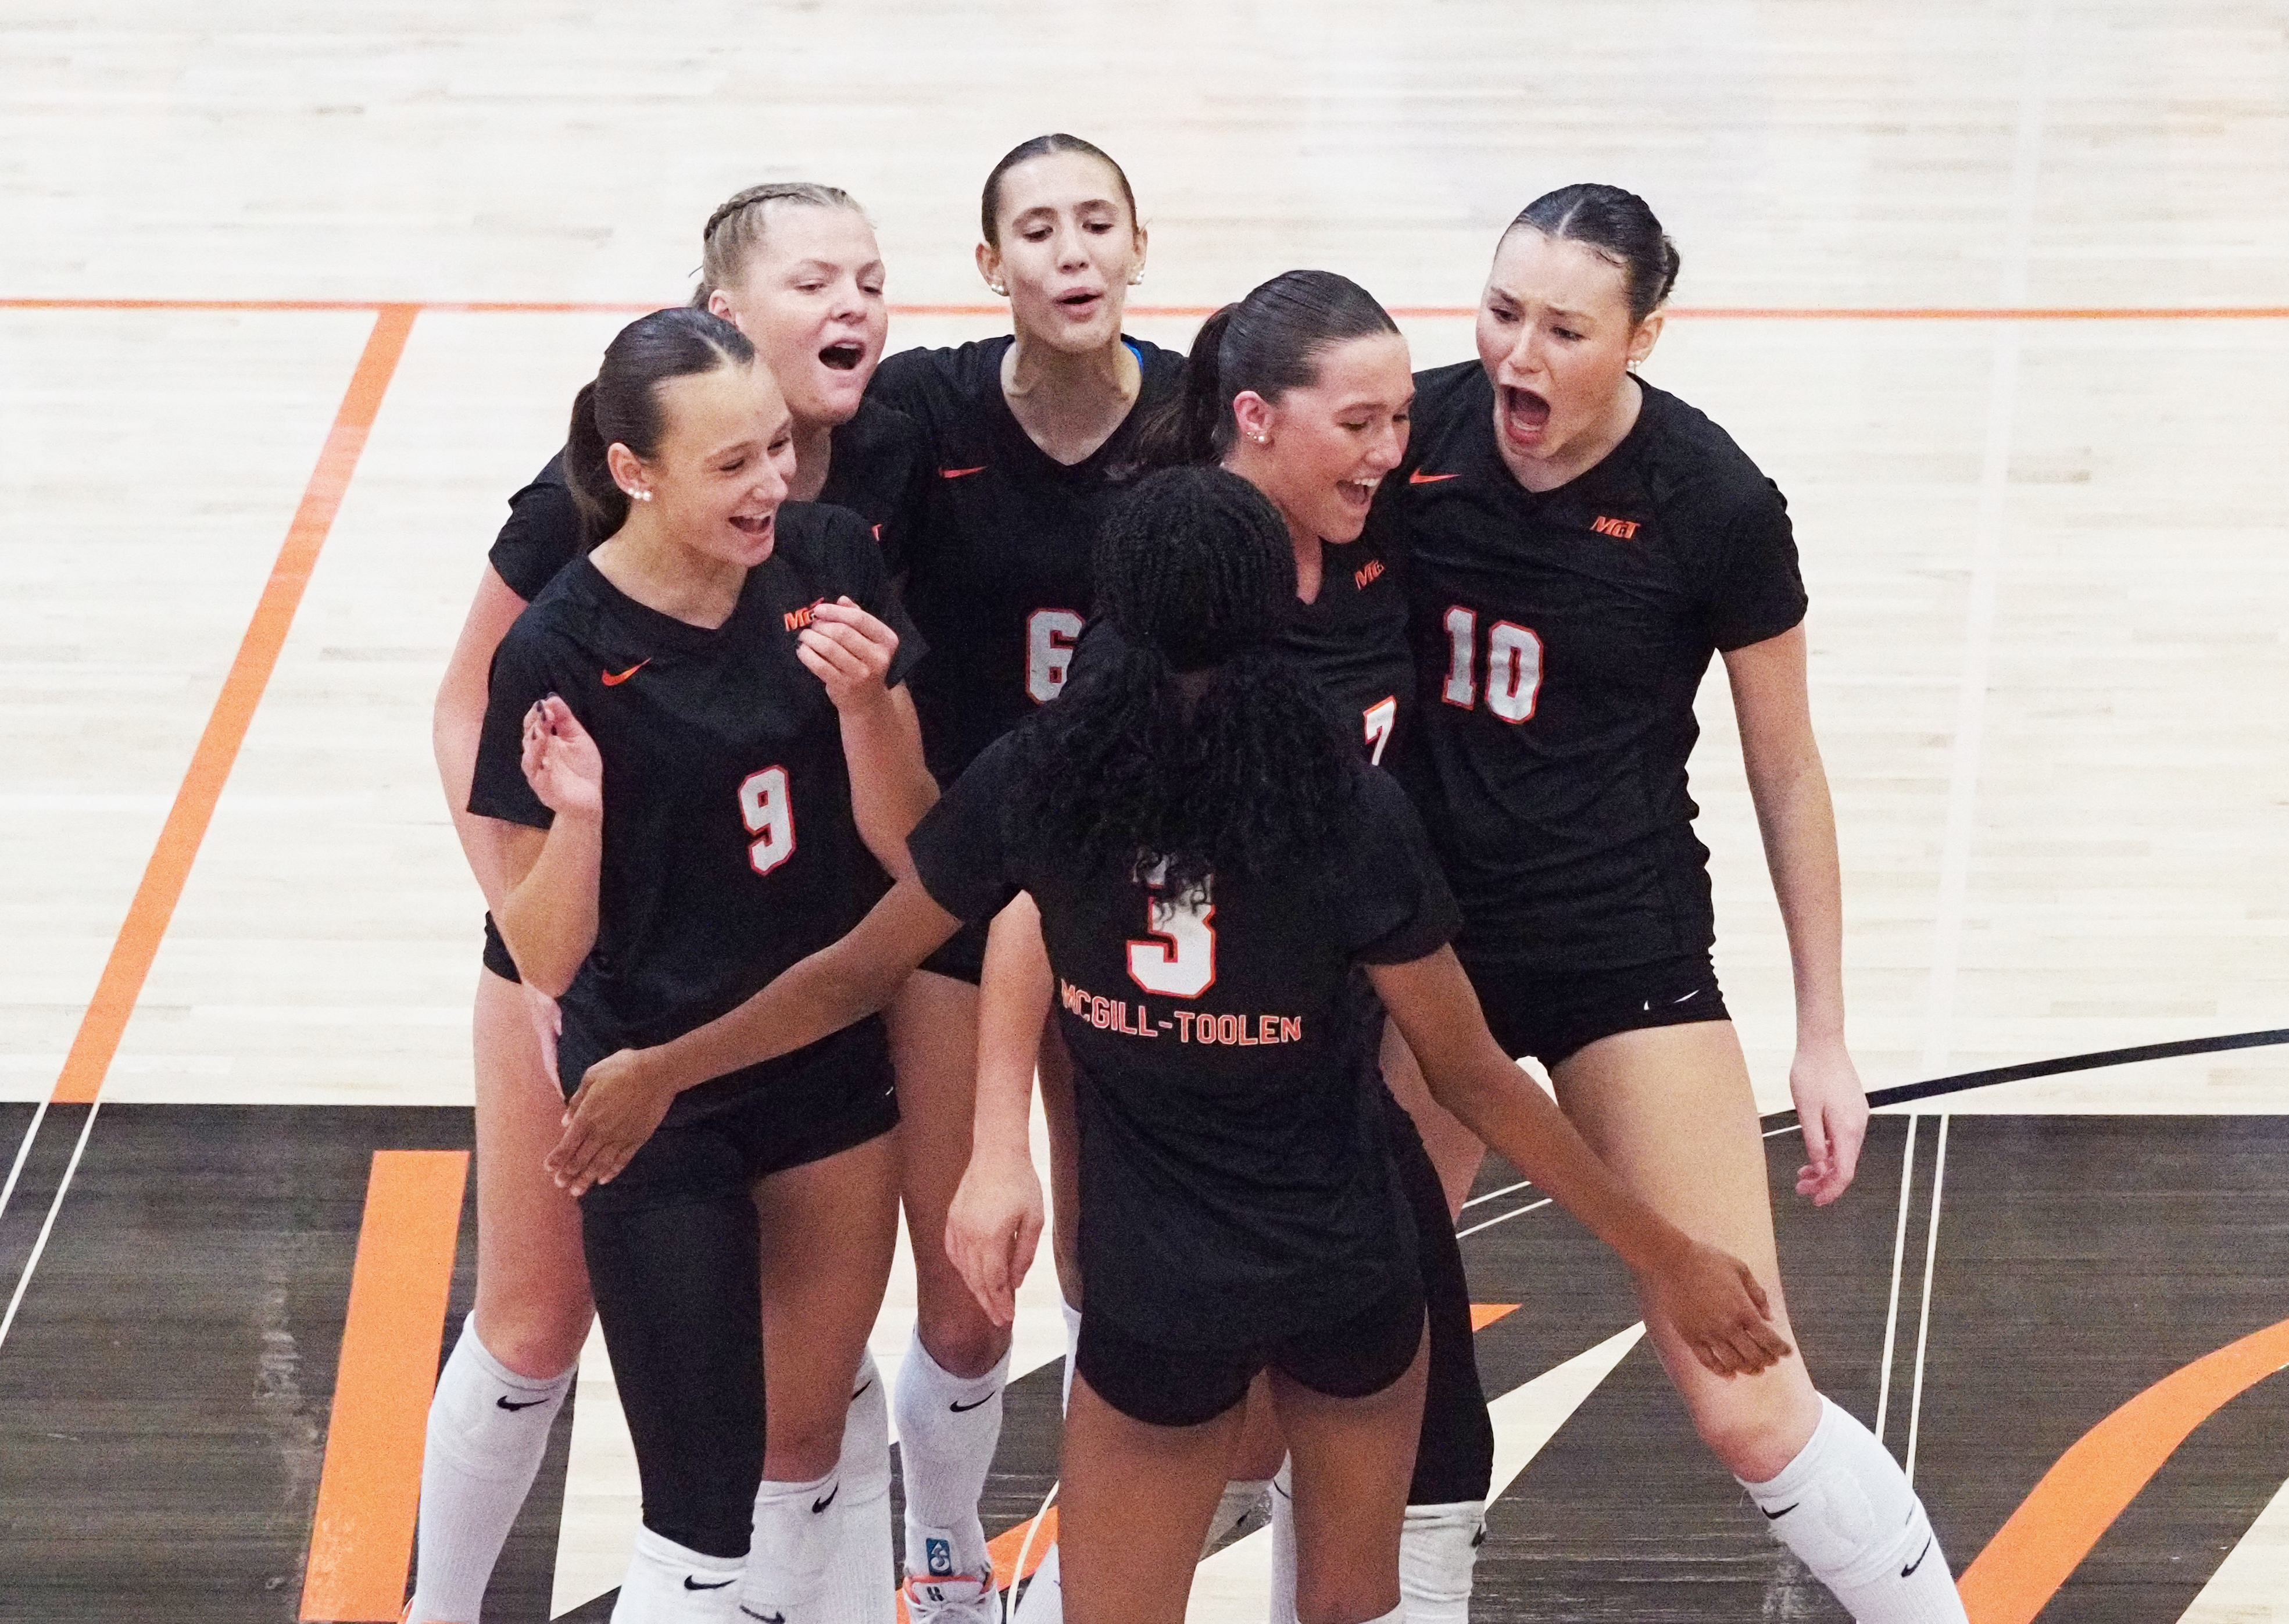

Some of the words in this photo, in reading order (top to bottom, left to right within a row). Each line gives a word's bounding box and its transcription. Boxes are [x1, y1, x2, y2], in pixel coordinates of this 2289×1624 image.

[1026, 608, 1085, 705] 6
[1442, 605, 1543, 724] 10
[1363, 695, 1396, 766] 7
[738, 765, 797, 875] 9
[1126, 846, 1217, 999] 3
[1061, 978, 1301, 1046] MCGILL-TOOLEN
